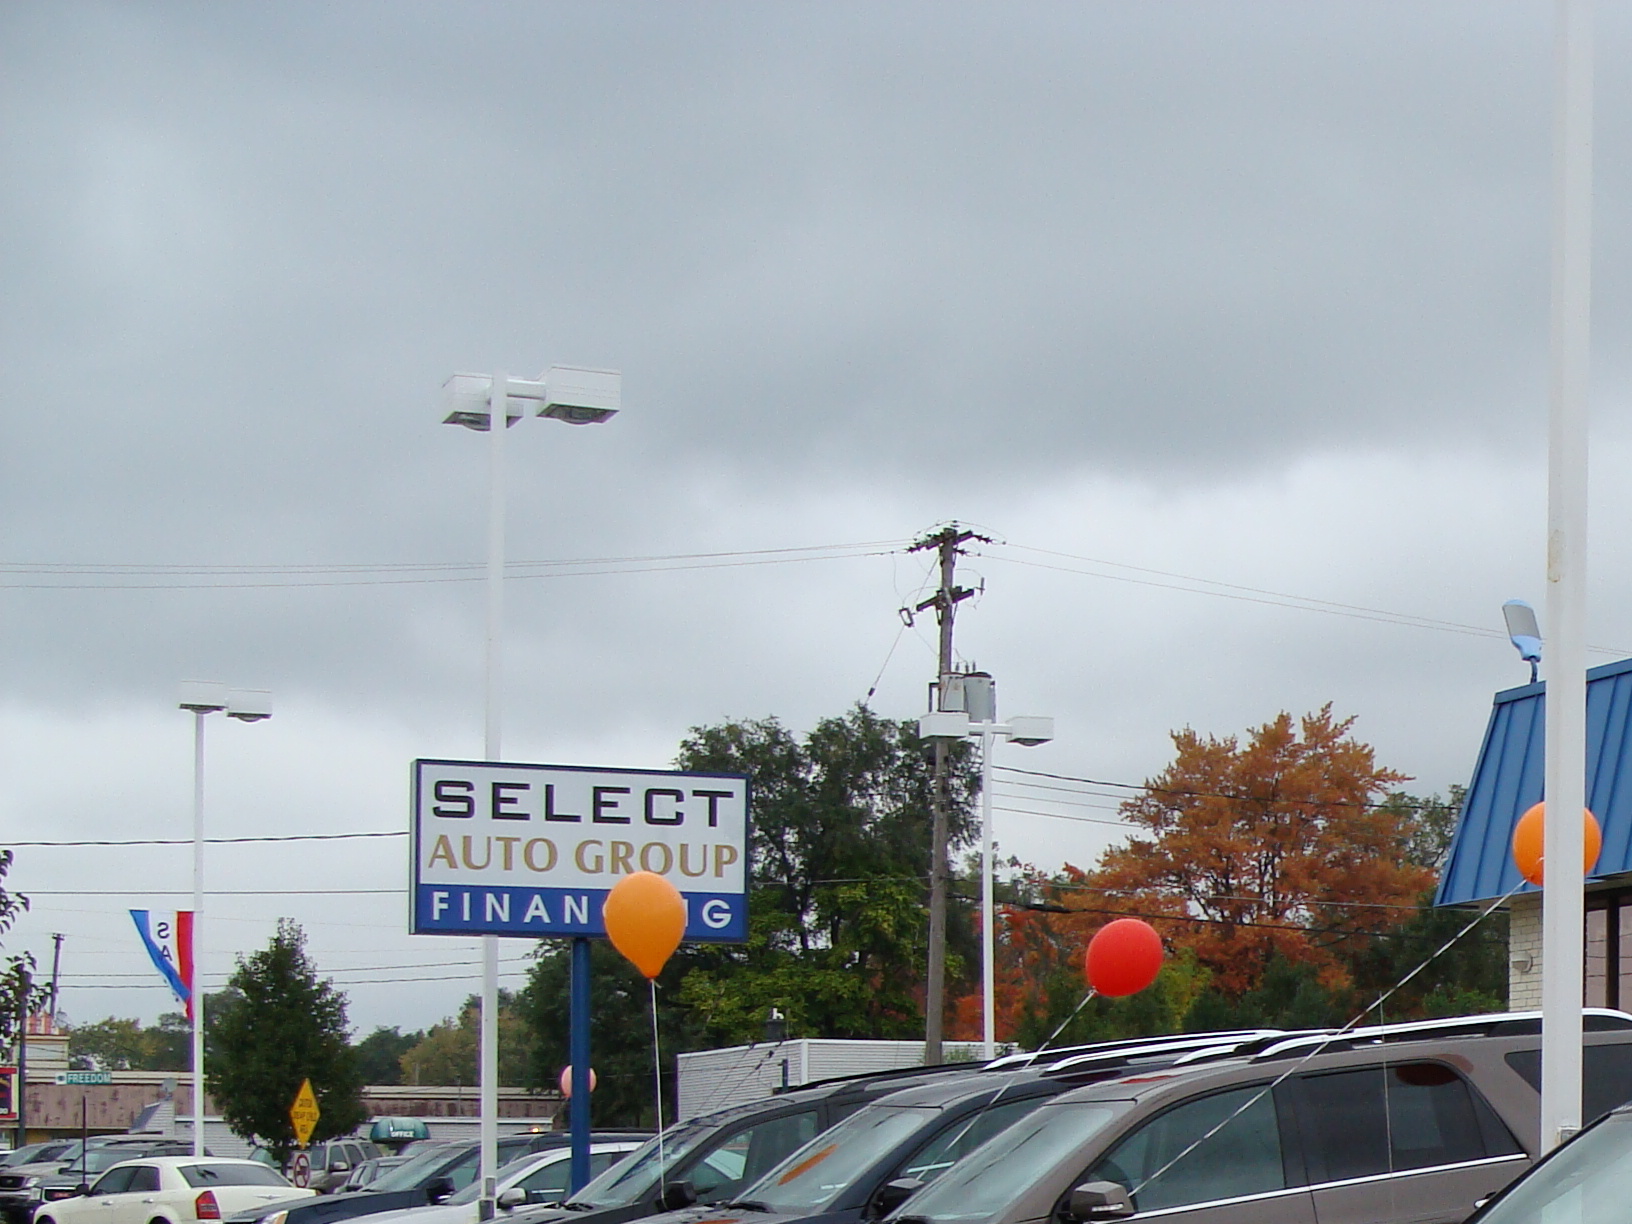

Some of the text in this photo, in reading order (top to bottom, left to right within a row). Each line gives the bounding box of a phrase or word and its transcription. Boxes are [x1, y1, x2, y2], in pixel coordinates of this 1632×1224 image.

[432, 779, 736, 828] SELECT
[428, 834, 739, 878] AUTO GROUP
[432, 891, 732, 930] FINANG
[67, 1072, 112, 1083] FREEDOM
